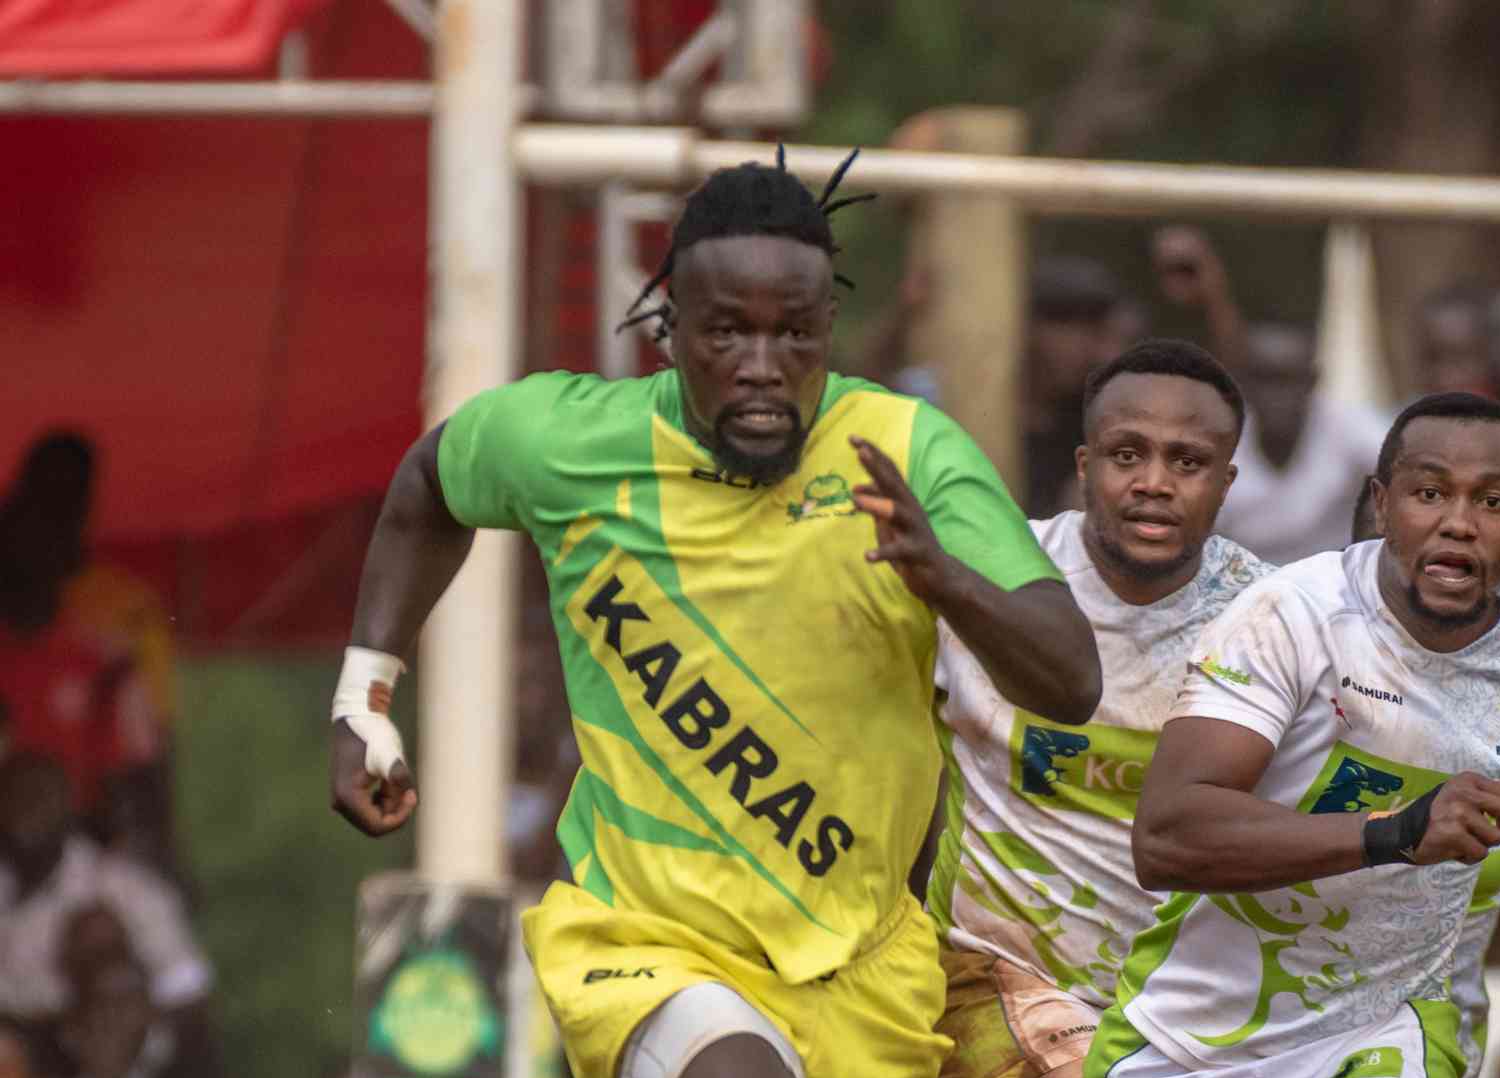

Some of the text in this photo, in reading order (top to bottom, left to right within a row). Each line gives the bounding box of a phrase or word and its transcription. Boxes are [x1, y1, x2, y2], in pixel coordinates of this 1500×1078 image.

[1352, 681, 1403, 706] SAMURAI
[584, 575, 855, 877] KABRAS
[1084, 753, 1146, 793] KC
[583, 965, 656, 984] BLK
